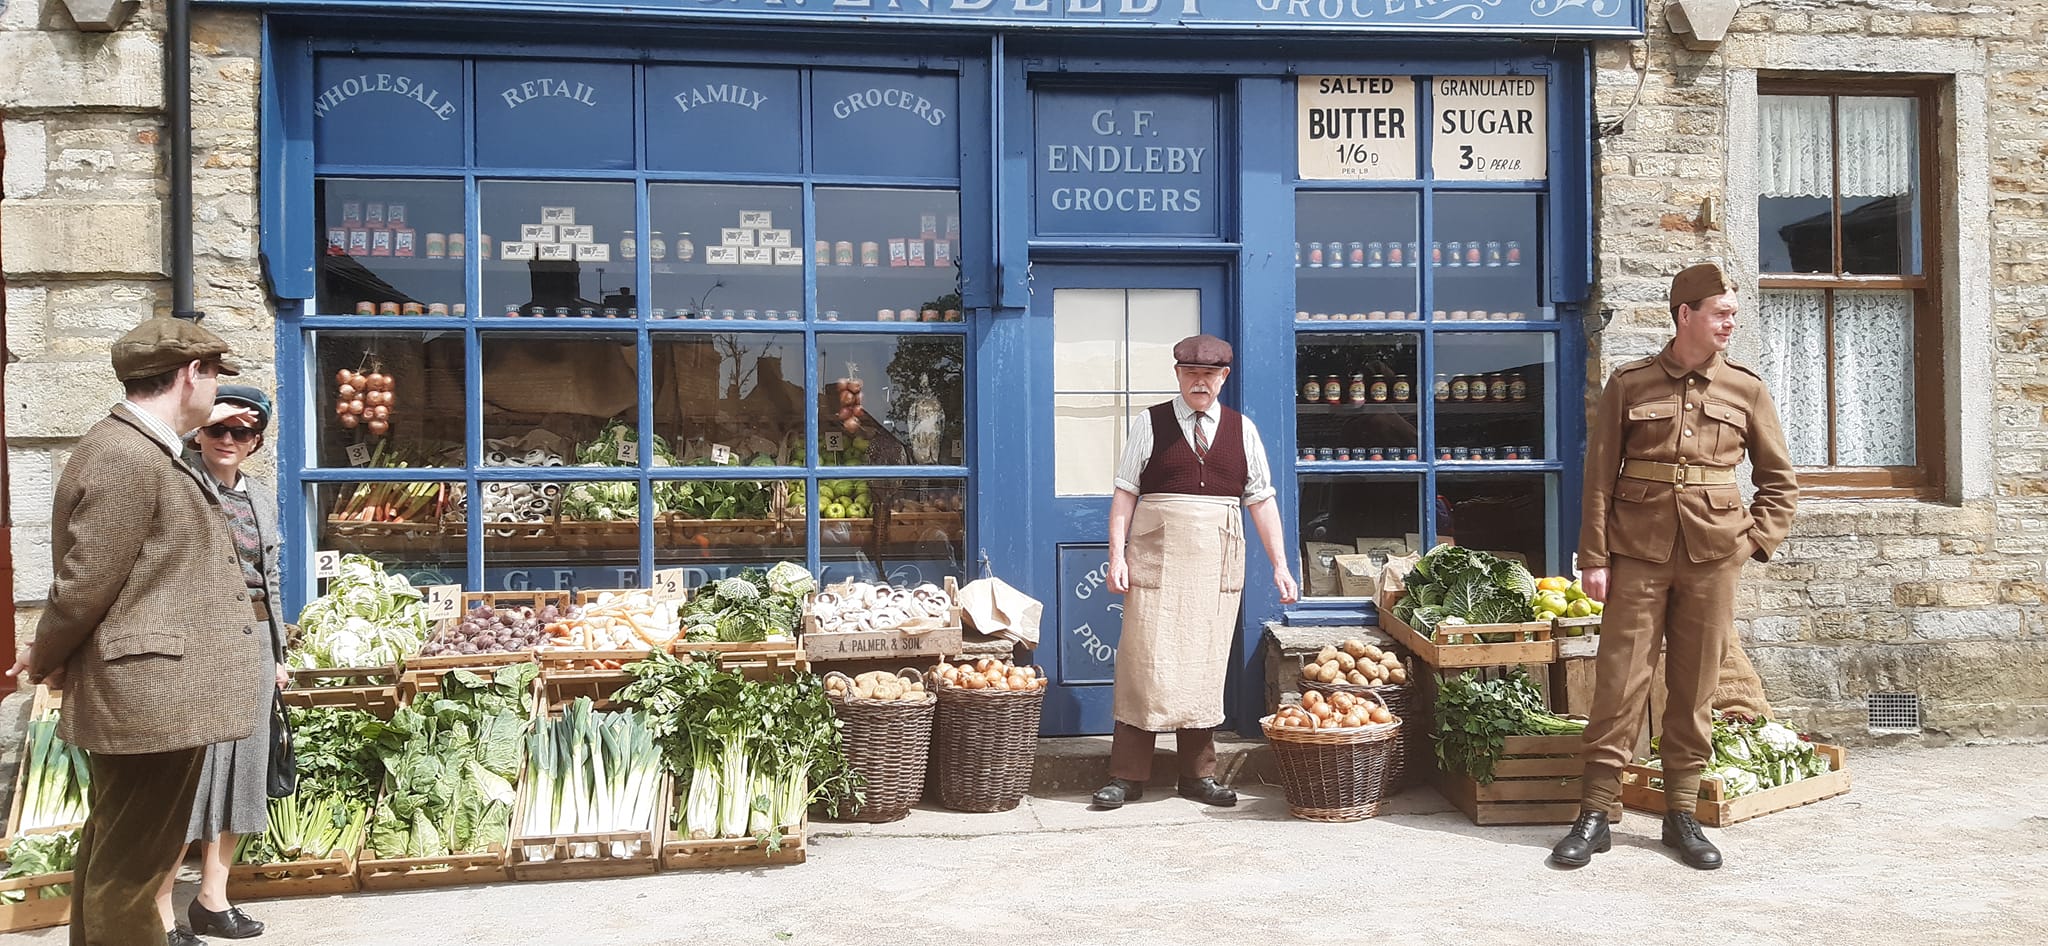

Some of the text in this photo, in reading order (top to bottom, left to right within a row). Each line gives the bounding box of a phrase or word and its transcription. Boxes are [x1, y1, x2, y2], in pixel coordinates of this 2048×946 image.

[313, 73, 456, 121] WHOLESALE
[501, 78, 597, 109] RETAIL
[674, 84, 768, 112] FAMILY
[1320, 78, 1394, 94] SALTED
[1440, 79, 1535, 97] GRANULATED
[833, 88, 946, 126] GROCERS
[1092, 109, 1159, 136] G. F.
[1309, 108, 1405, 139] BUTTER
[1441, 109, 1534, 134] SUGAR
[1048, 145, 1206, 173] ENDLEBY
[1459, 145, 1474, 170] 3
[1489, 159, 1508, 170] PER
[1052, 188, 1201, 212] GROCERS
[838, 641, 847, 653] A.
[891, 638, 898, 650] &
[1072, 622, 1117, 662] PRO
